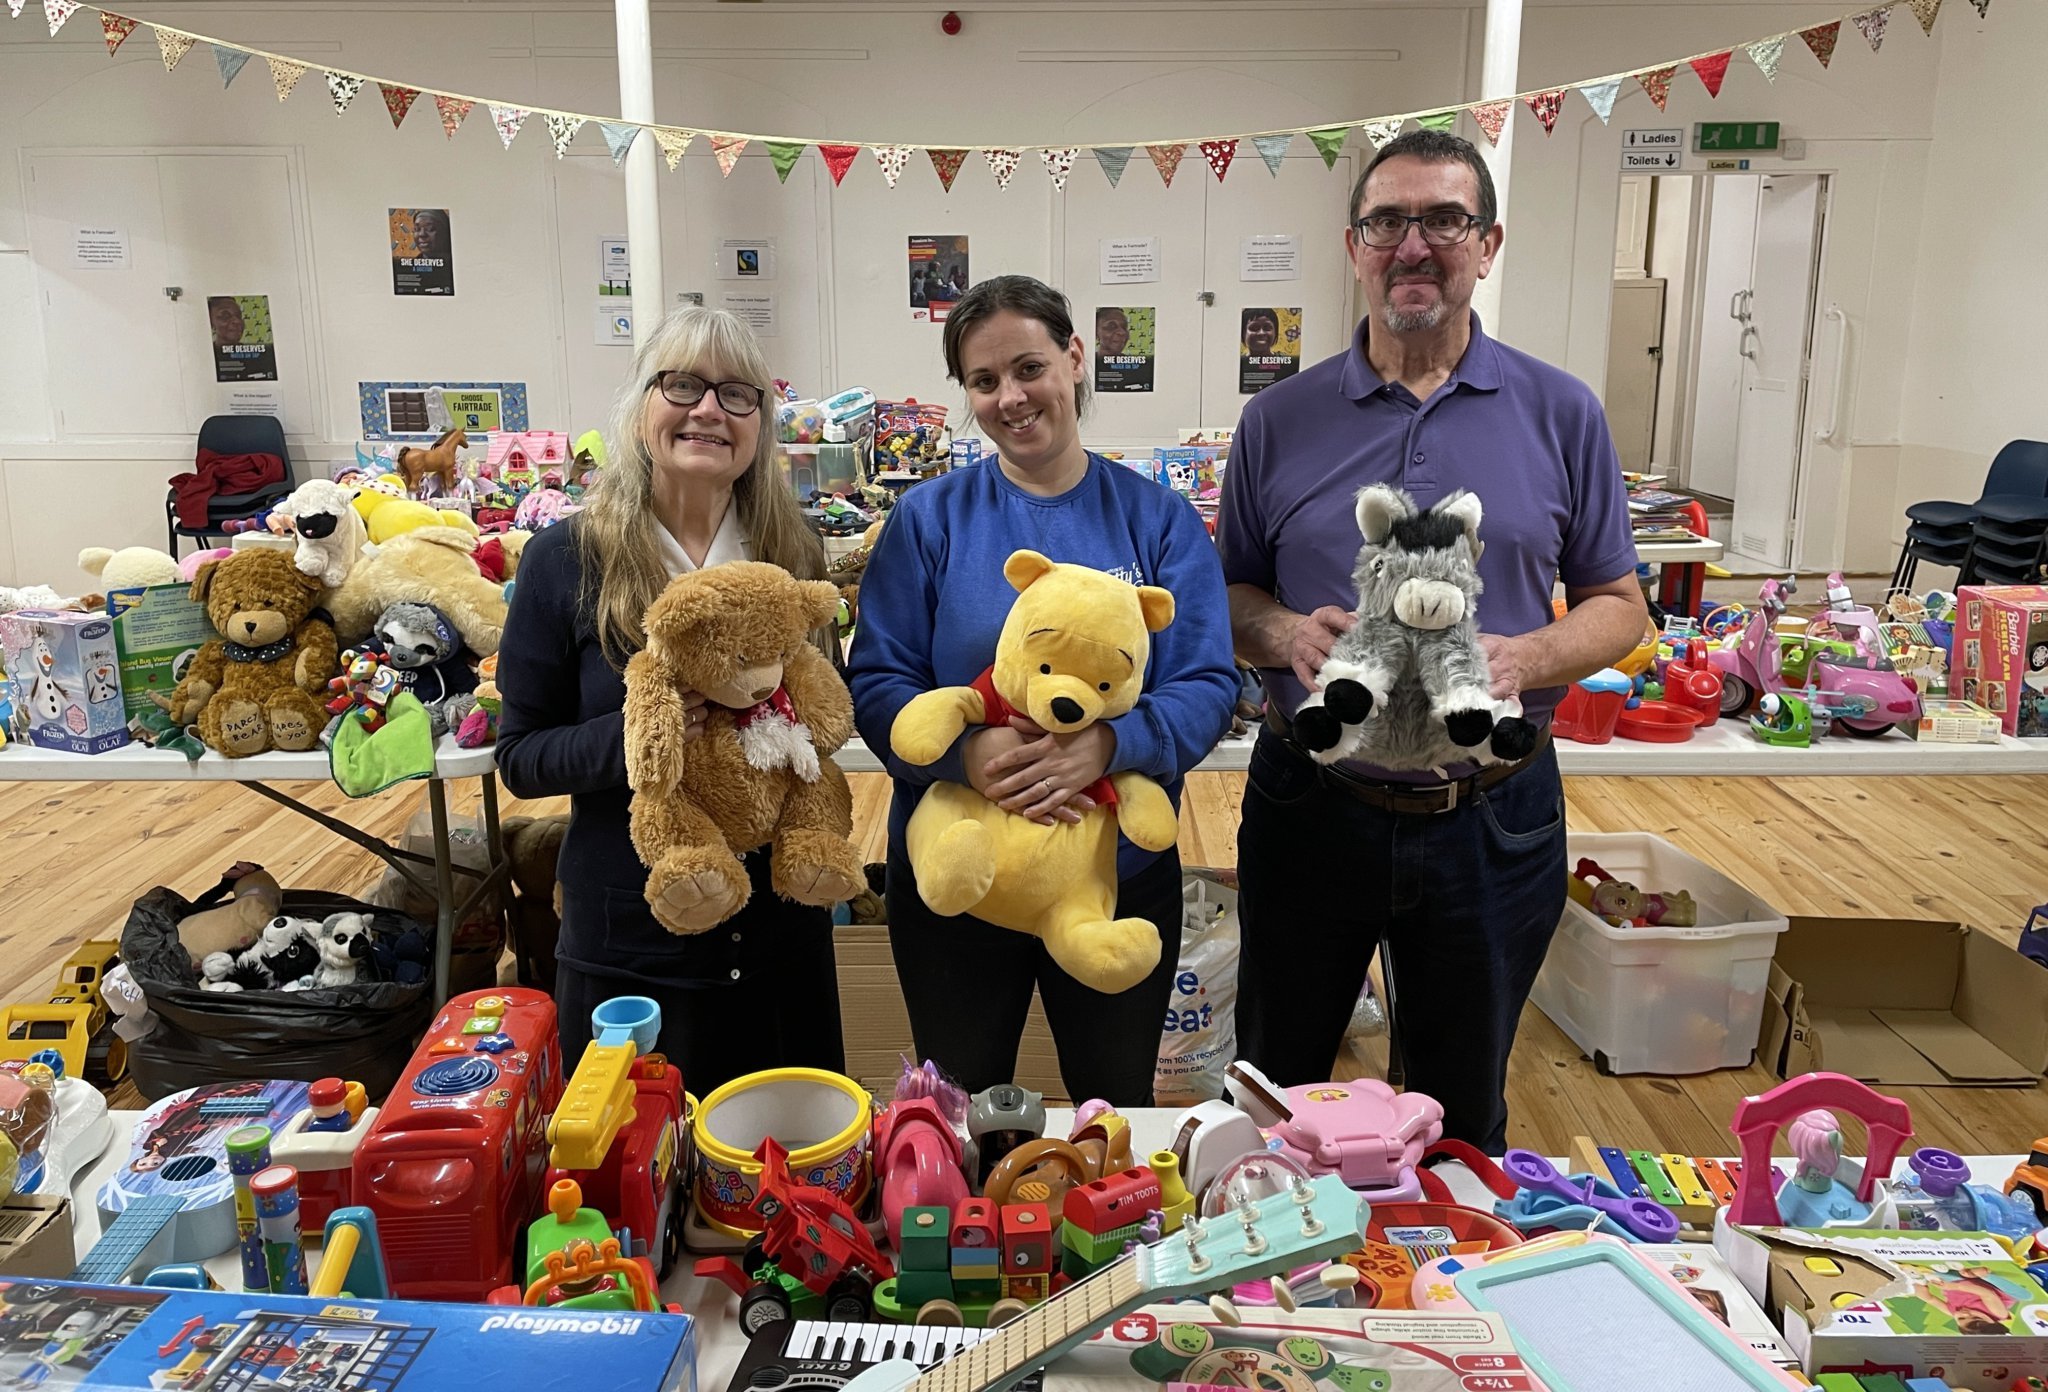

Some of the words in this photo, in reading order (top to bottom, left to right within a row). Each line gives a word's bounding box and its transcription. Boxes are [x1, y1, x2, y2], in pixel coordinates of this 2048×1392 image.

[1642, 134, 1676, 143] Ladies
[1627, 156, 1660, 166] Toilets
[400, 258, 413, 266] SHE
[413, 258, 444, 267] DESERVES
[221, 345, 235, 353] SHE
[235, 344, 266, 353] DESERVES
[1103, 356, 1116, 364] SHE
[1116, 355, 1146, 364] DESERVES
[1248, 356, 1261, 365] SHE
[1261, 356, 1292, 365] DESERVES
[460, 394, 484, 402] CHOOSE
[453, 402, 493, 412] FAIRTRADE
[83, 627, 106, 638] FROZEN
[1999, 610, 2010, 651] PICNIC
[2006, 611, 2020, 656] Barbie
[2002, 654, 2011, 681] VAN
[398, 670, 418, 683] EEP
[226, 712, 258, 732] DARCY
[42, 729, 65, 740] FROZEN
[71, 743, 89, 752] OLAF
[98, 738, 121, 751] OLAF
[1171, 972, 1206, 996] e.
[1174, 1054, 1196, 1064] 100%
[1174, 1067, 1189, 1076] you
[809, 1147, 862, 1184] BAND
[1118, 1193, 1134, 1207] TIM
[1134, 1185, 1159, 1201] TOOTS
[1373, 1248, 1398, 1261] A
[1357, 1258, 1379, 1271] C
[1381, 1262, 1407, 1279] B
[479, 1312, 645, 1336] playmobil
[797, 1362, 825, 1370] KEY
[828, 1362, 852, 1372] 61
[1493, 1357, 1506, 1368] 8
